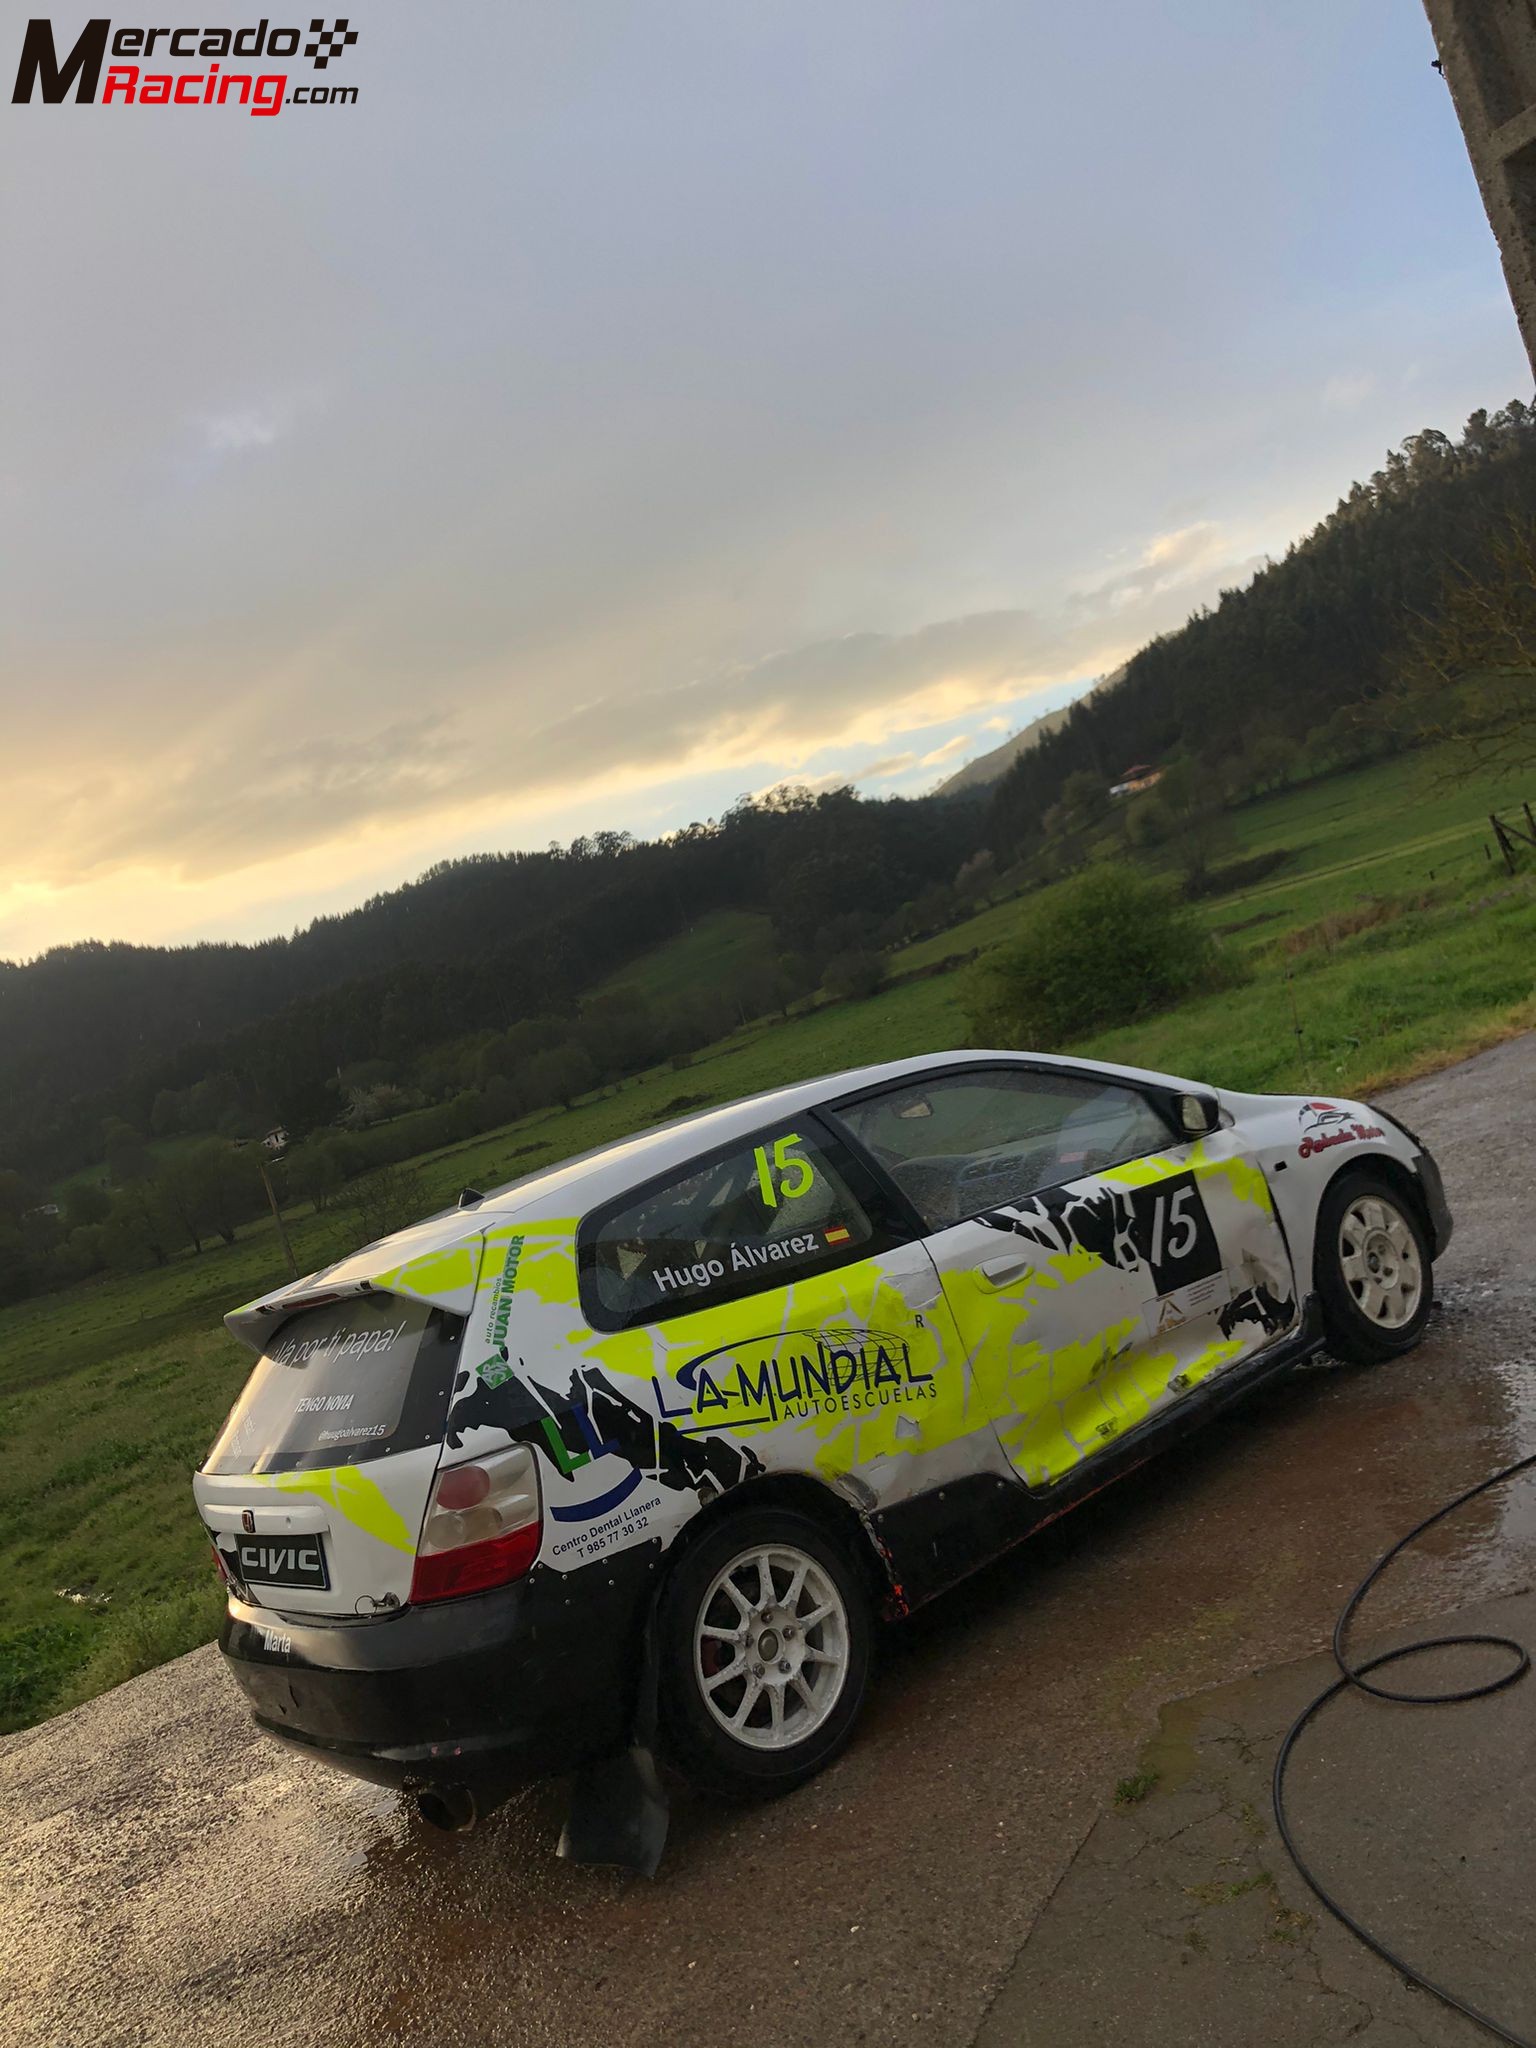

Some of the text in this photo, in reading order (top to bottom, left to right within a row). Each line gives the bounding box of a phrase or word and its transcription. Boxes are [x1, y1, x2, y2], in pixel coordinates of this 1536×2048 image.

[754, 1133, 814, 1207] 15
[1150, 1185, 1197, 1267] 15
[652, 1232, 819, 1293] Hugo Álvarez
[484, 1277, 502, 1344] auto recambios
[492, 1235, 525, 1351] JUAN MOTOR
[288, 1337, 329, 1370] por
[323, 1327, 347, 1358] ti
[295, 1394, 355, 1413] TENGO NOVIA
[651, 1341, 934, 1422] LA MUNDIAL
[784, 1383, 938, 1420] AUTOESCUELAS
[552, 1497, 662, 1557] Centro Dental Llanera
[576, 1516, 649, 1559] T 985 77 30 32
[241, 1547, 320, 1575] CIVIC
[264, 1629, 292, 1654] Marta
